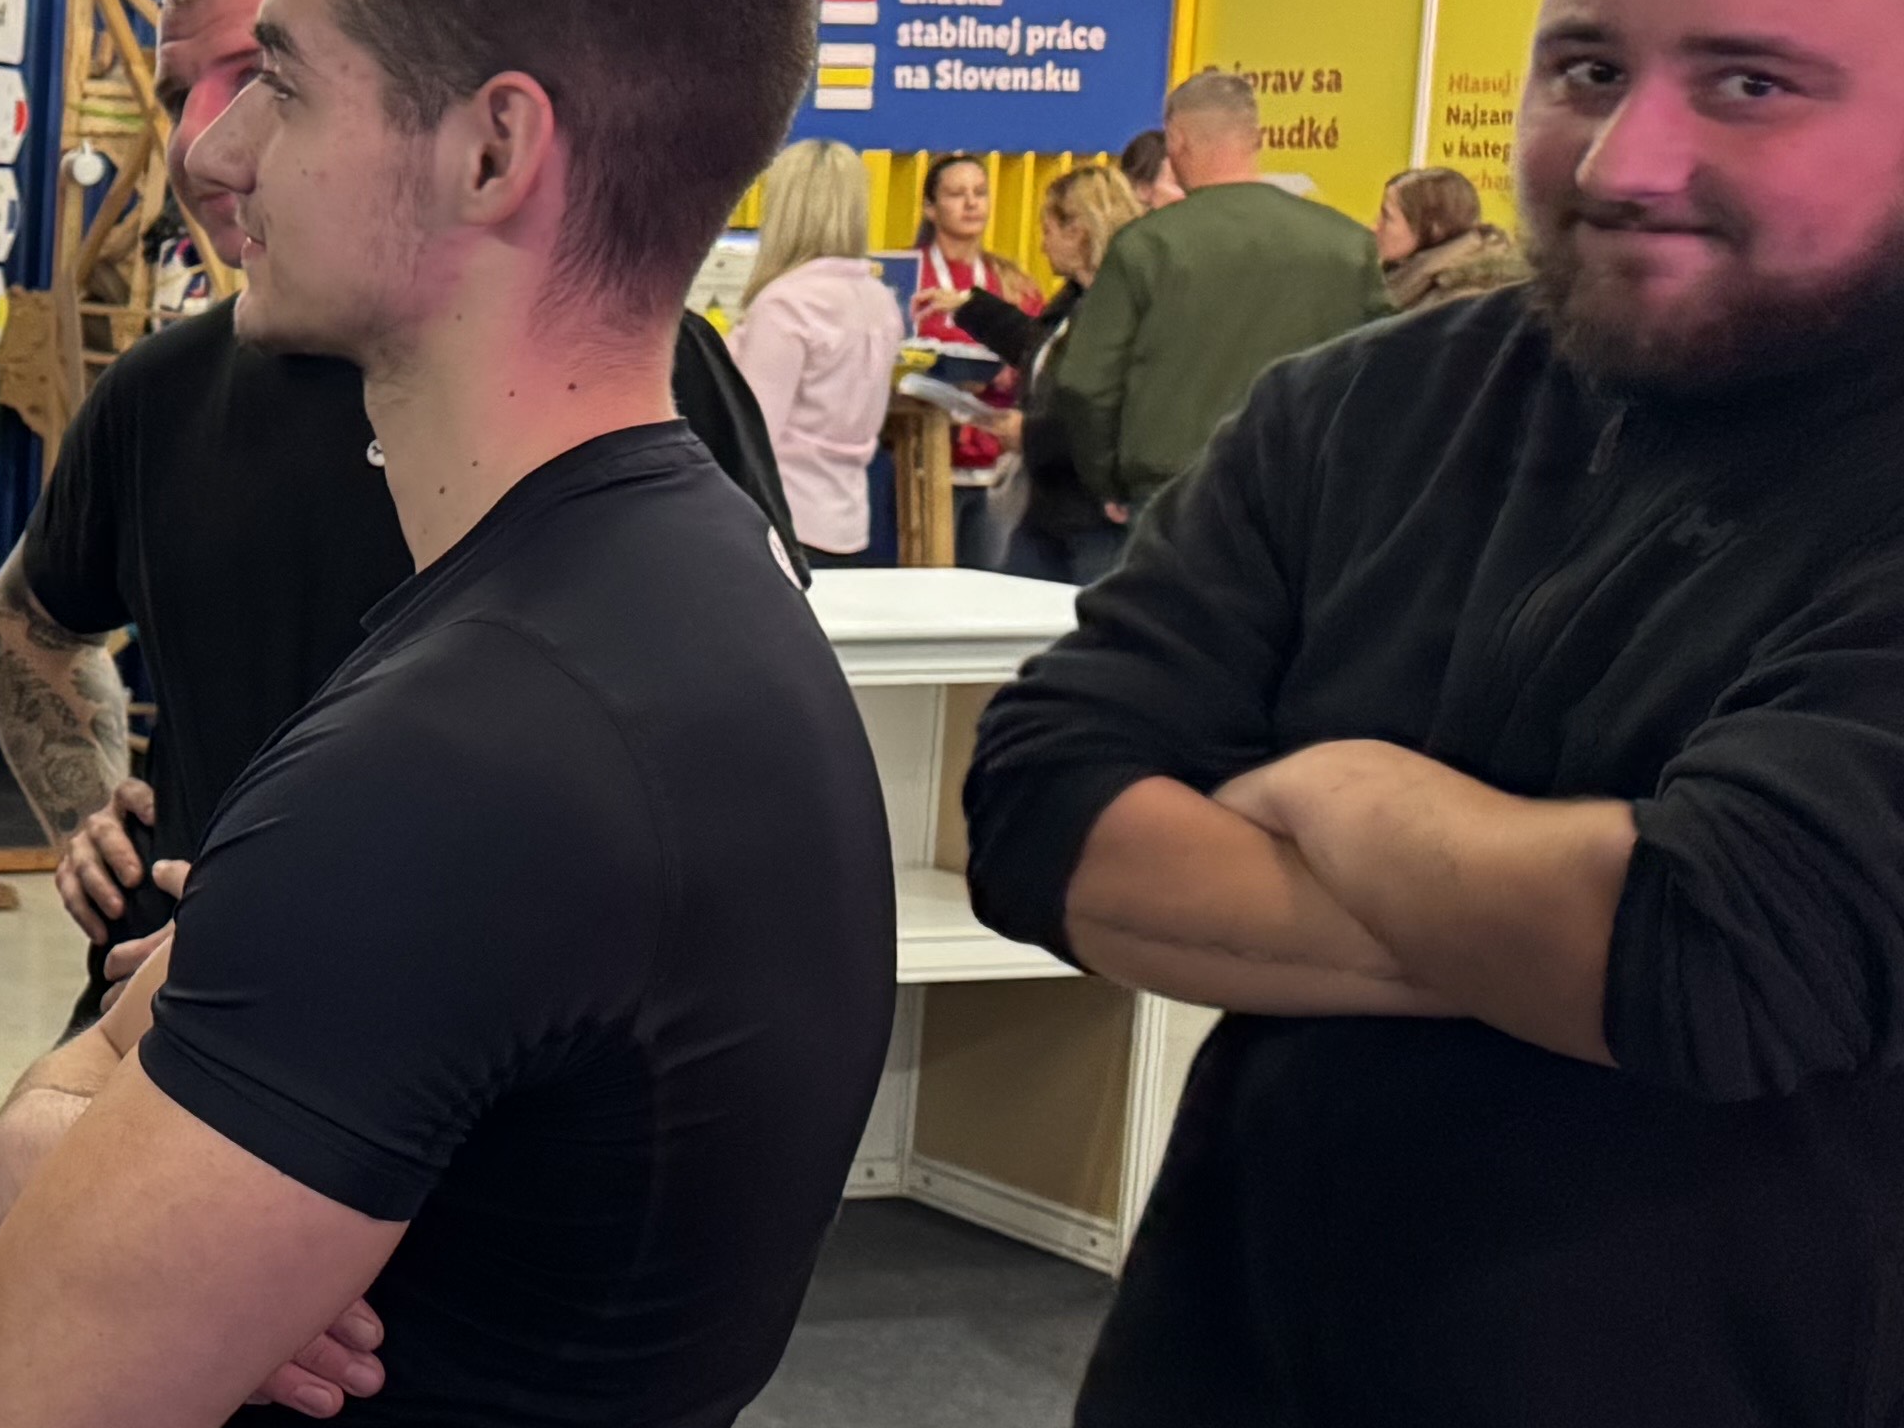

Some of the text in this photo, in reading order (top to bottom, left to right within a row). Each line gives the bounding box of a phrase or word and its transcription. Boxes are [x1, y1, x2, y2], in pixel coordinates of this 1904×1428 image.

[896, 15, 1107, 56] stabilnej práce
[894, 58, 1081, 92] na Slovensku
[1311, 70, 1343, 94] sa
